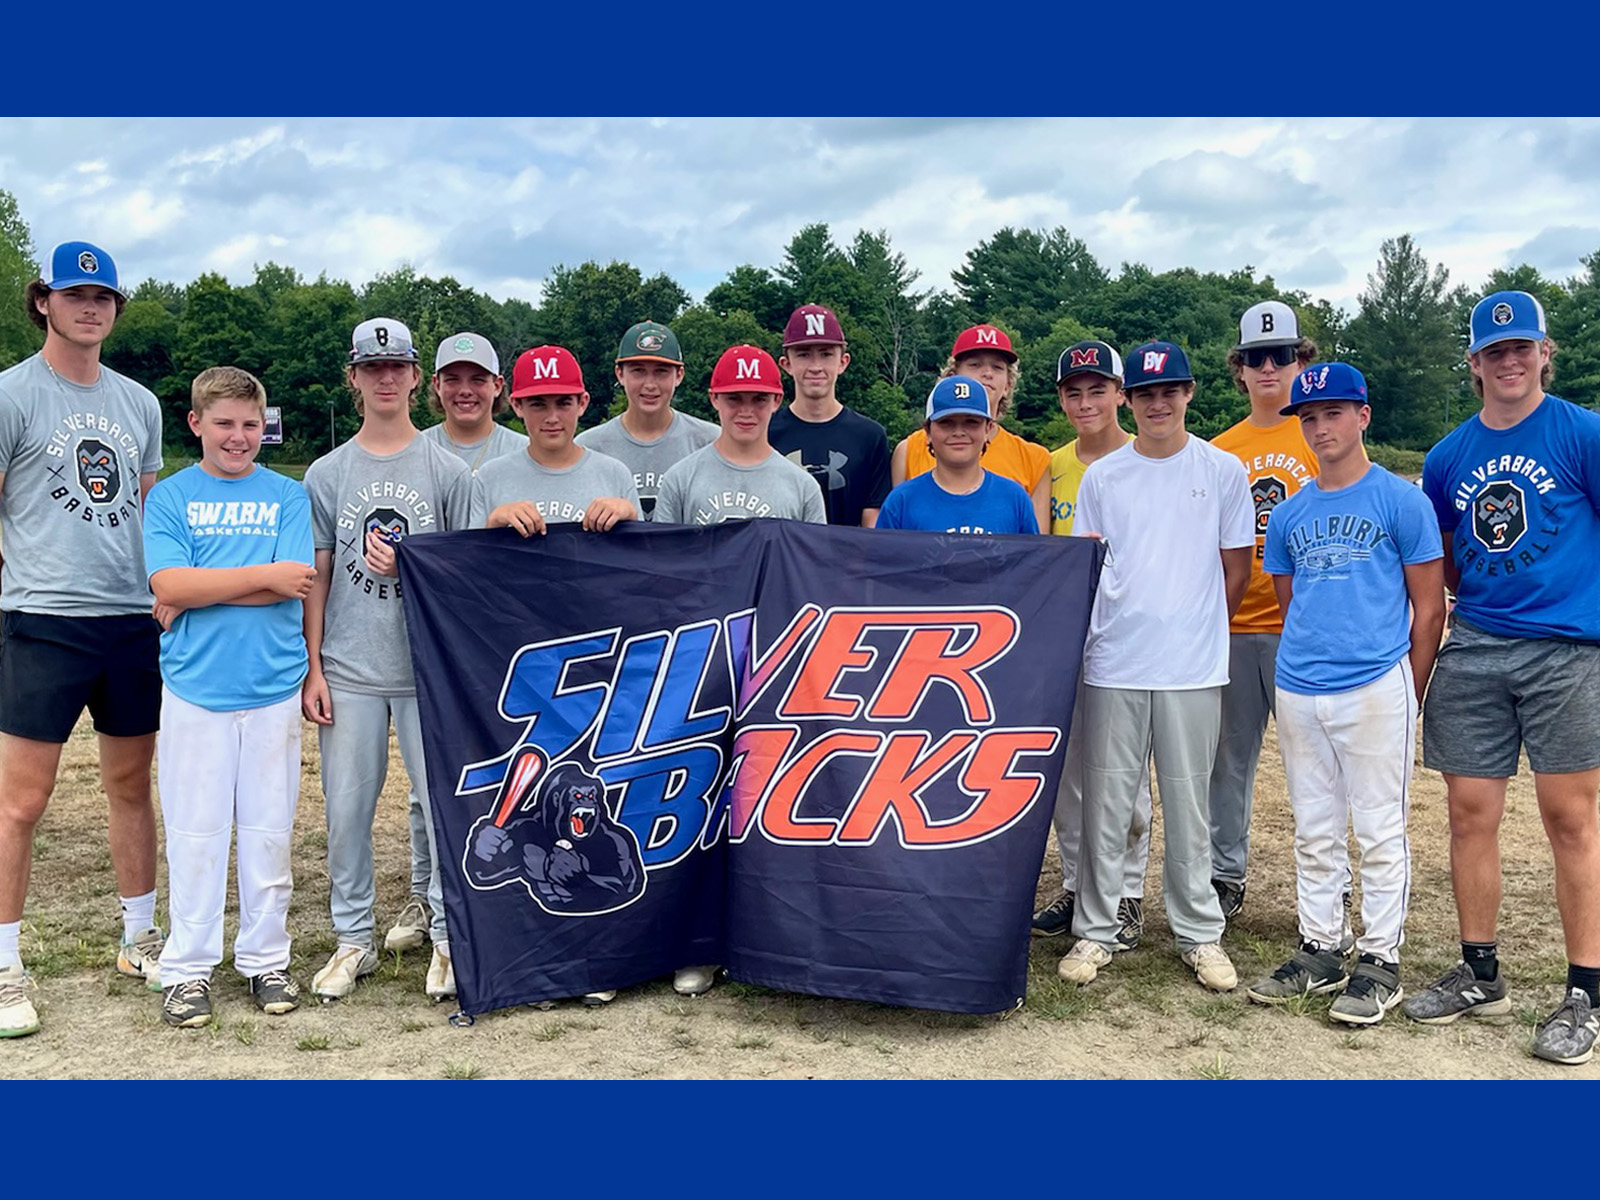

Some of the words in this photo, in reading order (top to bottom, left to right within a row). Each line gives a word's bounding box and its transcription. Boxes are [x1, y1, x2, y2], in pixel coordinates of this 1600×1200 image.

[805, 313, 825, 336] N
[1261, 313, 1274, 333] B
[374, 327, 389, 346] B
[976, 328, 998, 345] M
[533, 357, 560, 379] M
[736, 358, 761, 379] M
[1070, 348, 1099, 368] M
[954, 383, 970, 399] D
[46, 413, 139, 458] SILVERBACK
[1244, 453, 1311, 487] VERBACK
[1455, 455, 1556, 511] SILVERBACK
[187, 501, 280, 526] SWARM
[337, 481, 435, 530] SILVERBACK
[696, 491, 776, 525] ILVERBA
[193, 527, 278, 536] ASKETBALL
[1289, 514, 1389, 554] ILLBURY
[346, 560, 402, 599] BASEB
[455, 603, 1020, 796] SILVER
[590, 726, 1062, 870] BACKS
[1460, 985, 1487, 1004] N
